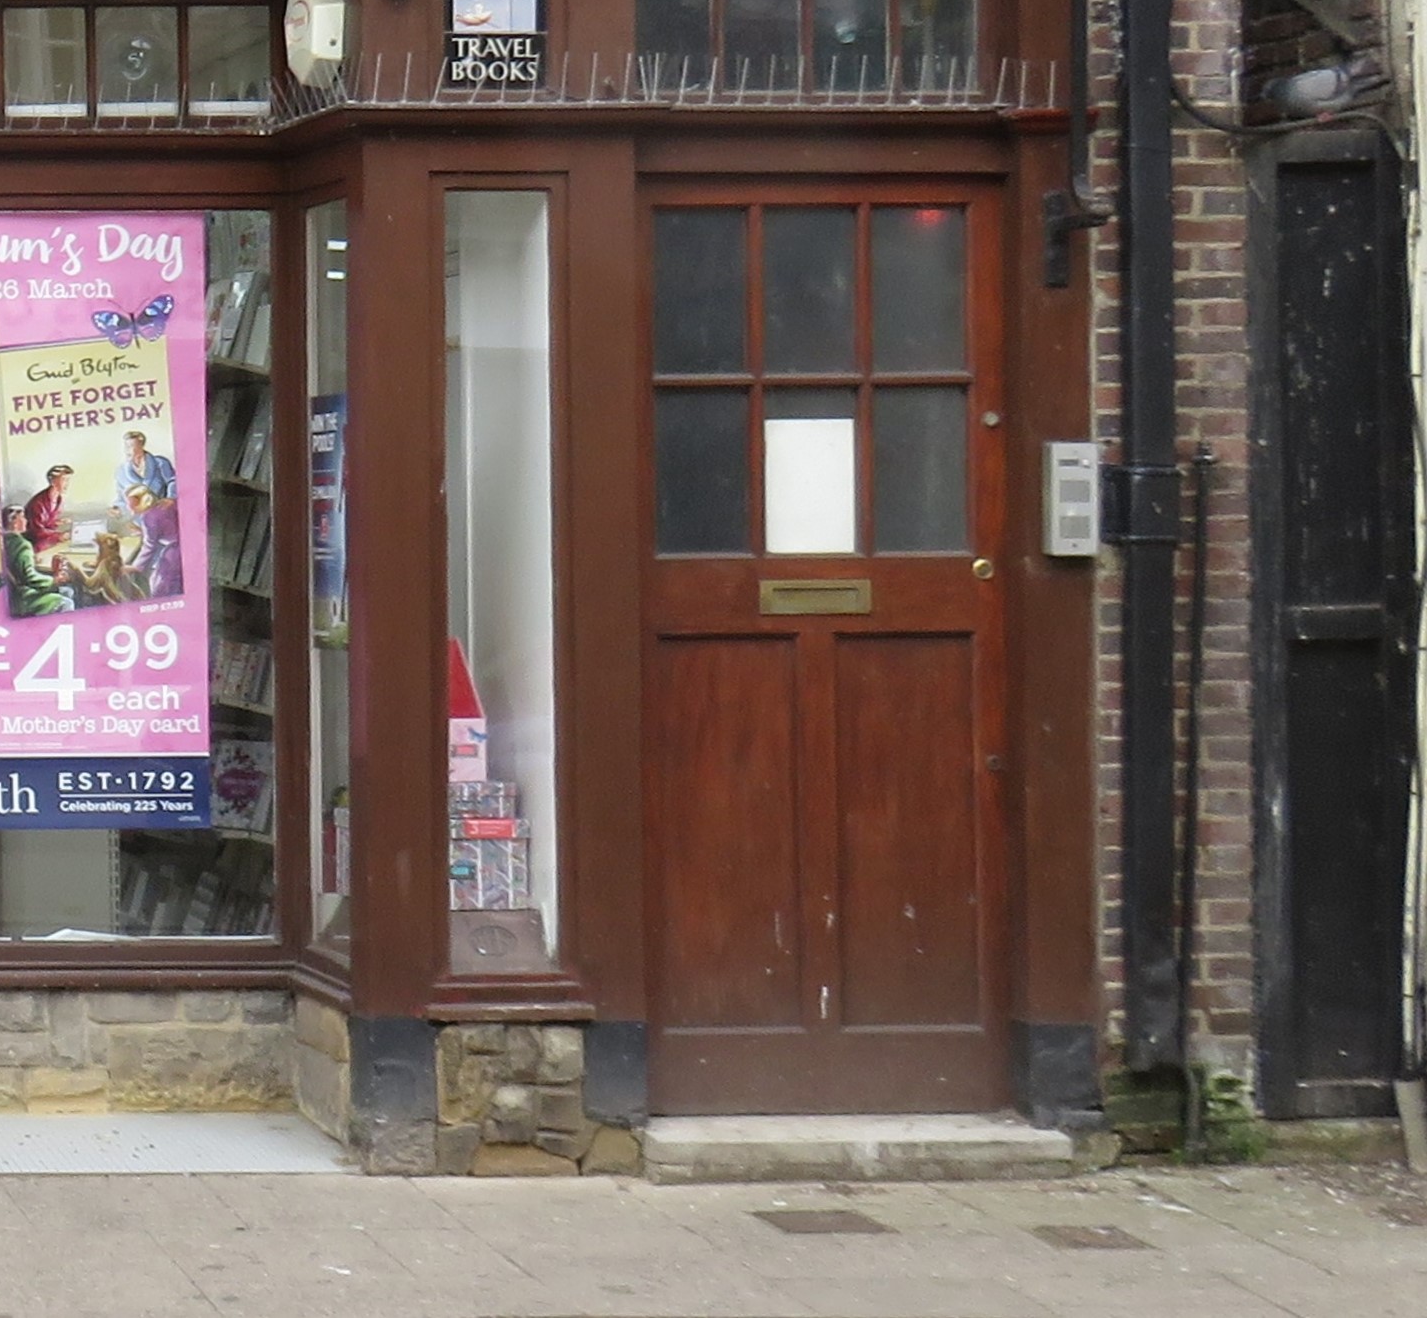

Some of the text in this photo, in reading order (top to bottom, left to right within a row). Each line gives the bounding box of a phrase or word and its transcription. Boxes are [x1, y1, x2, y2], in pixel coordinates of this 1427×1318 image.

[452, 37, 537, 59] TRAVEL
[451, 60, 537, 83] BOOKS
[96, 223, 185, 281] Day
[26, 278, 114, 299] March
[26, 355, 141, 382] Enid Blyton
[12, 380, 158, 413] FIVE FORGET
[9, 402, 165, 436] MOTHER'S DAY
[106, 684, 181, 711] each
[0, 714, 96, 735] Mother's
[100, 715, 146, 738] Day
[149, 714, 201, 734] card
[59, 799, 194, 814] Celebrating 225 Years
